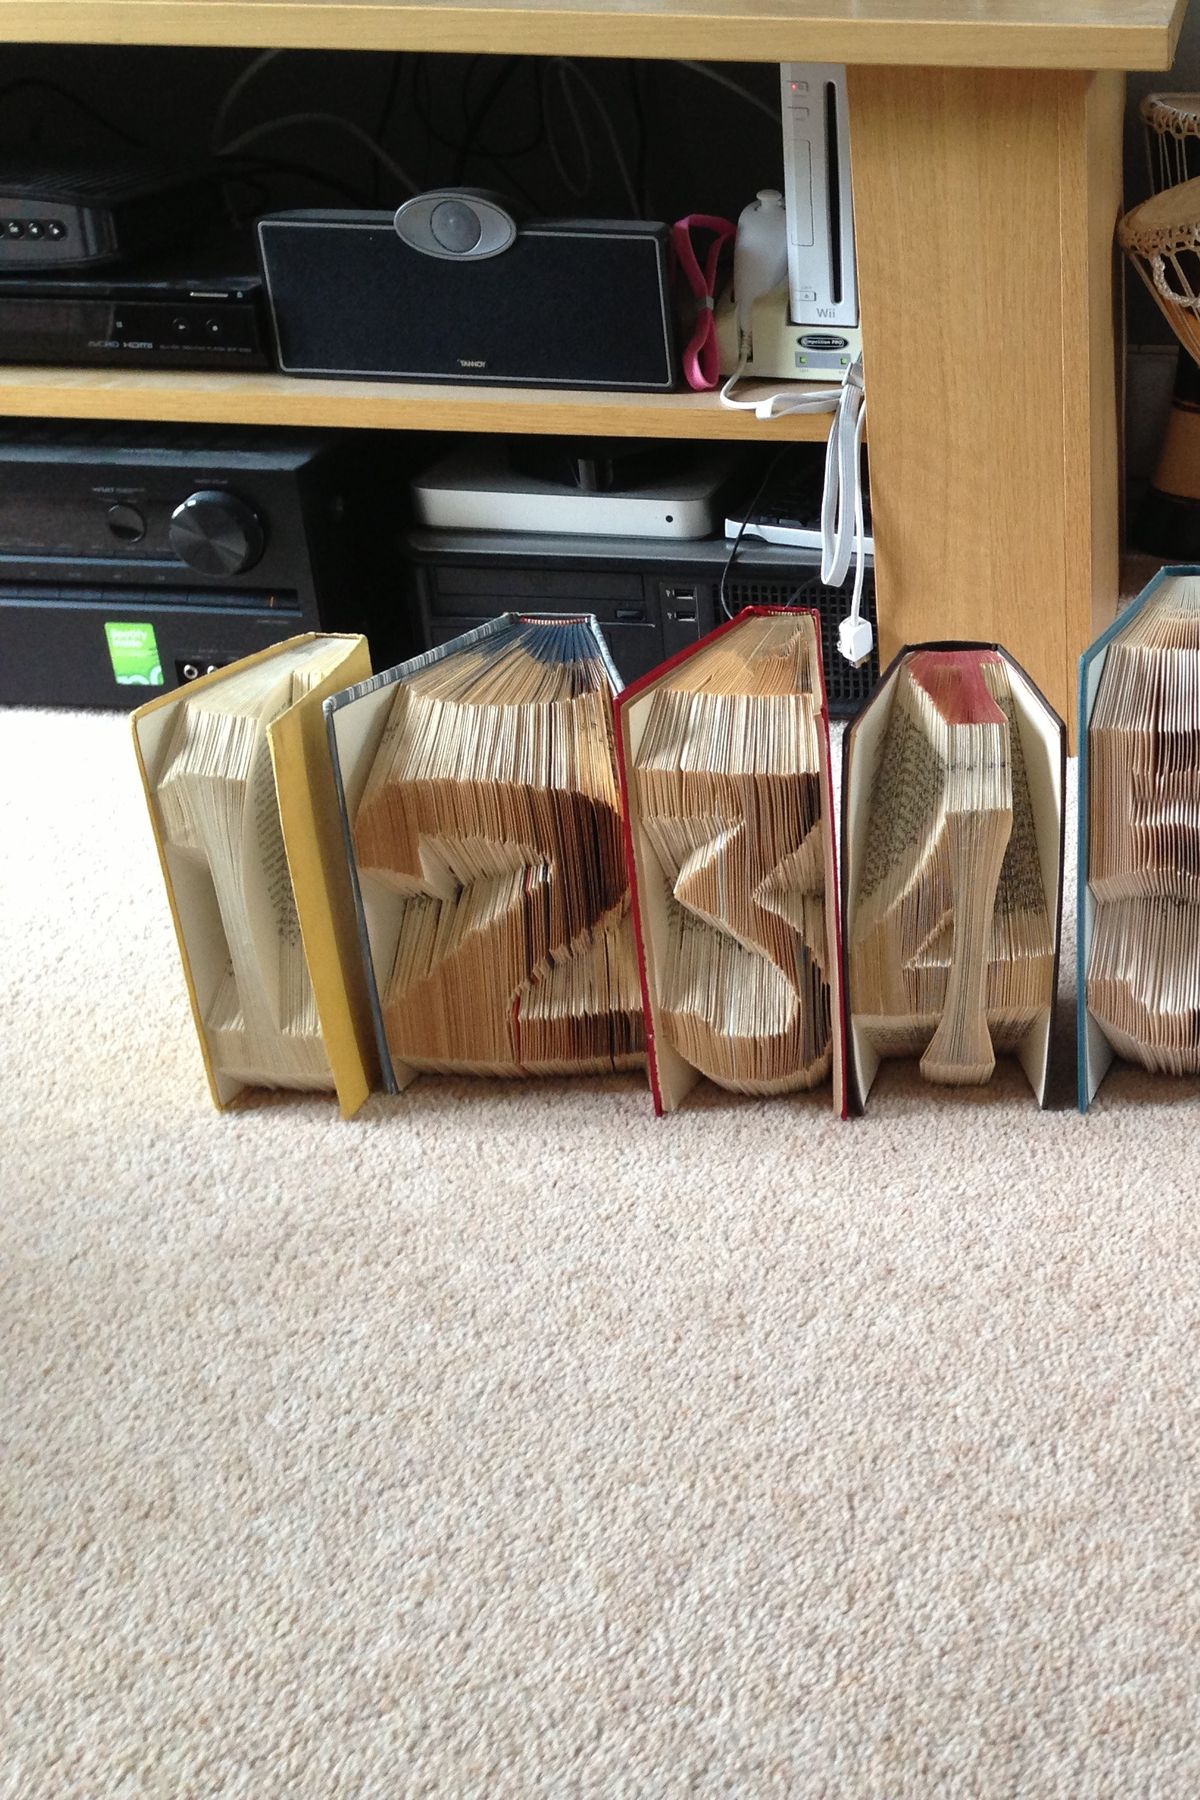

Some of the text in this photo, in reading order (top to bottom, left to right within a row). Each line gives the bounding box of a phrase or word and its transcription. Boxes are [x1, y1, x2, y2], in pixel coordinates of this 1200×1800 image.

[816, 307, 836, 319] Wii
[157, 773, 334, 1091] 1
[354, 778, 649, 1077] 2
[636, 767, 832, 1096] 3
[849, 808, 1057, 1084] 4
